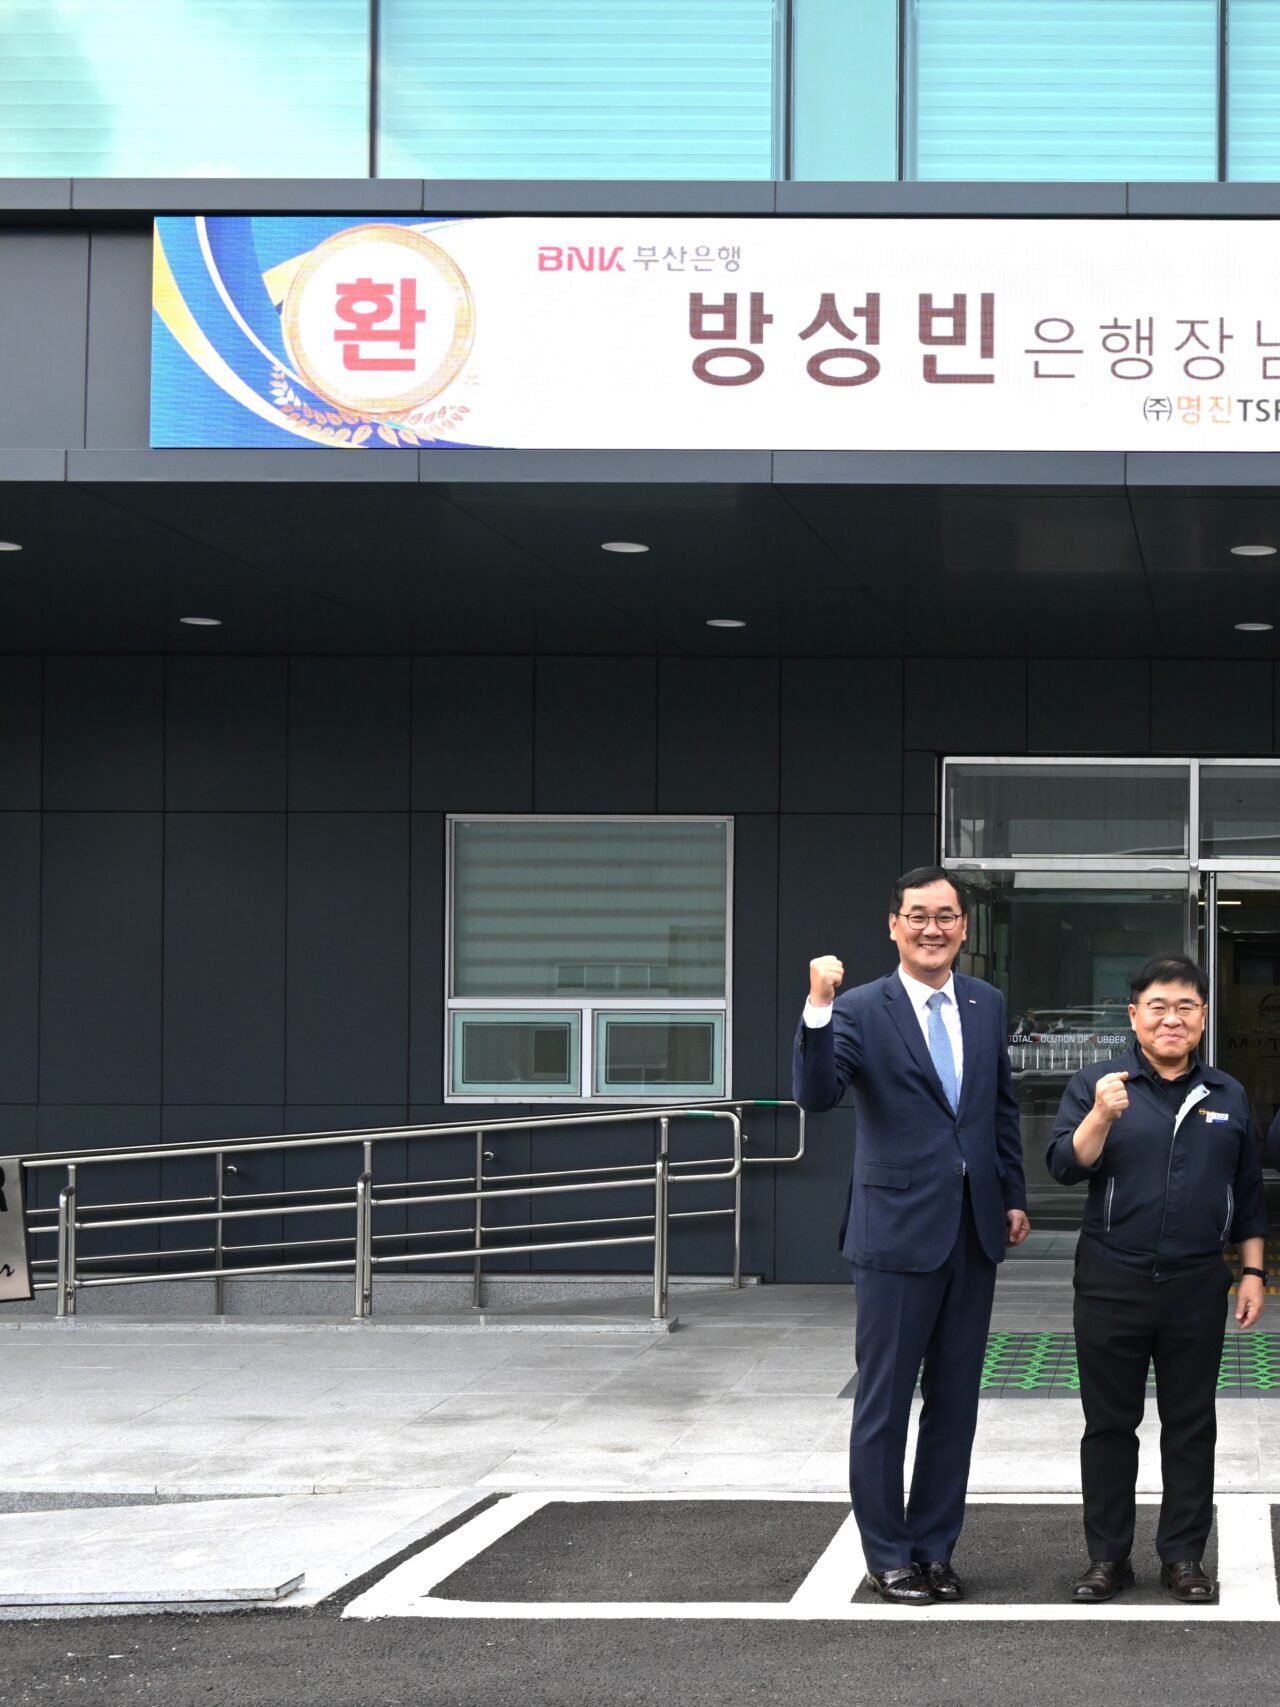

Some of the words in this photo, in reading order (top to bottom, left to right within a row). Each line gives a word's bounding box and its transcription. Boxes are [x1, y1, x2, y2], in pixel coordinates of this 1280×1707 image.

[538, 246, 625, 272] BNK
[638, 246, 740, 273] 부산은행
[333, 277, 426, 371] 환
[1077, 1034, 1090, 1043] OF
